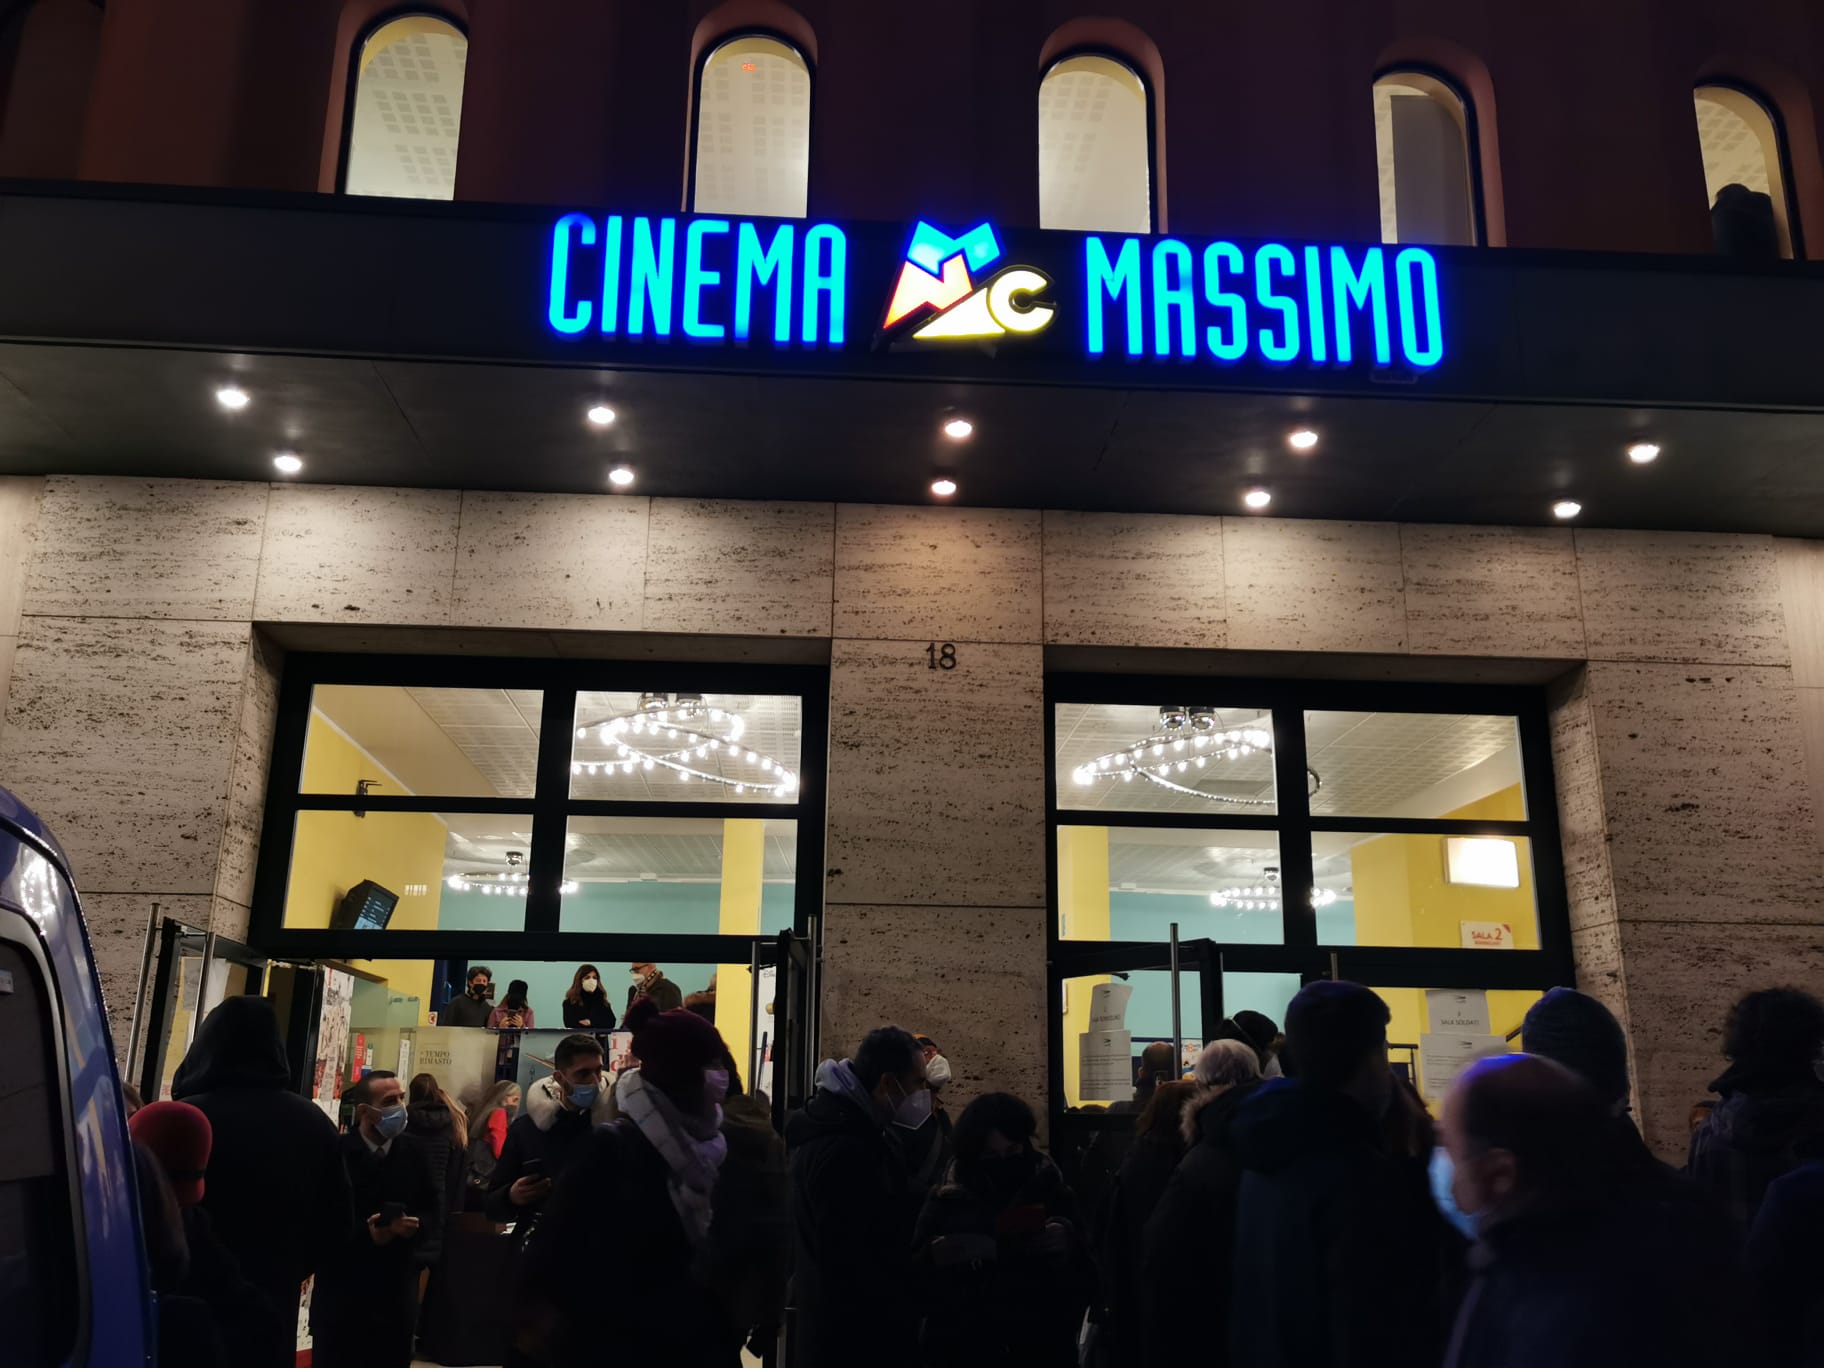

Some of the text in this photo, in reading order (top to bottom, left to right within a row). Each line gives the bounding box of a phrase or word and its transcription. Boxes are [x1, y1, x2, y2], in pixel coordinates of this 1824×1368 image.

[549, 214, 846, 343] CINEMA
[1086, 236, 1443, 366] MASSIMO
[926, 642, 956, 670] 18
[1472, 927, 1503, 941] SALA 2
